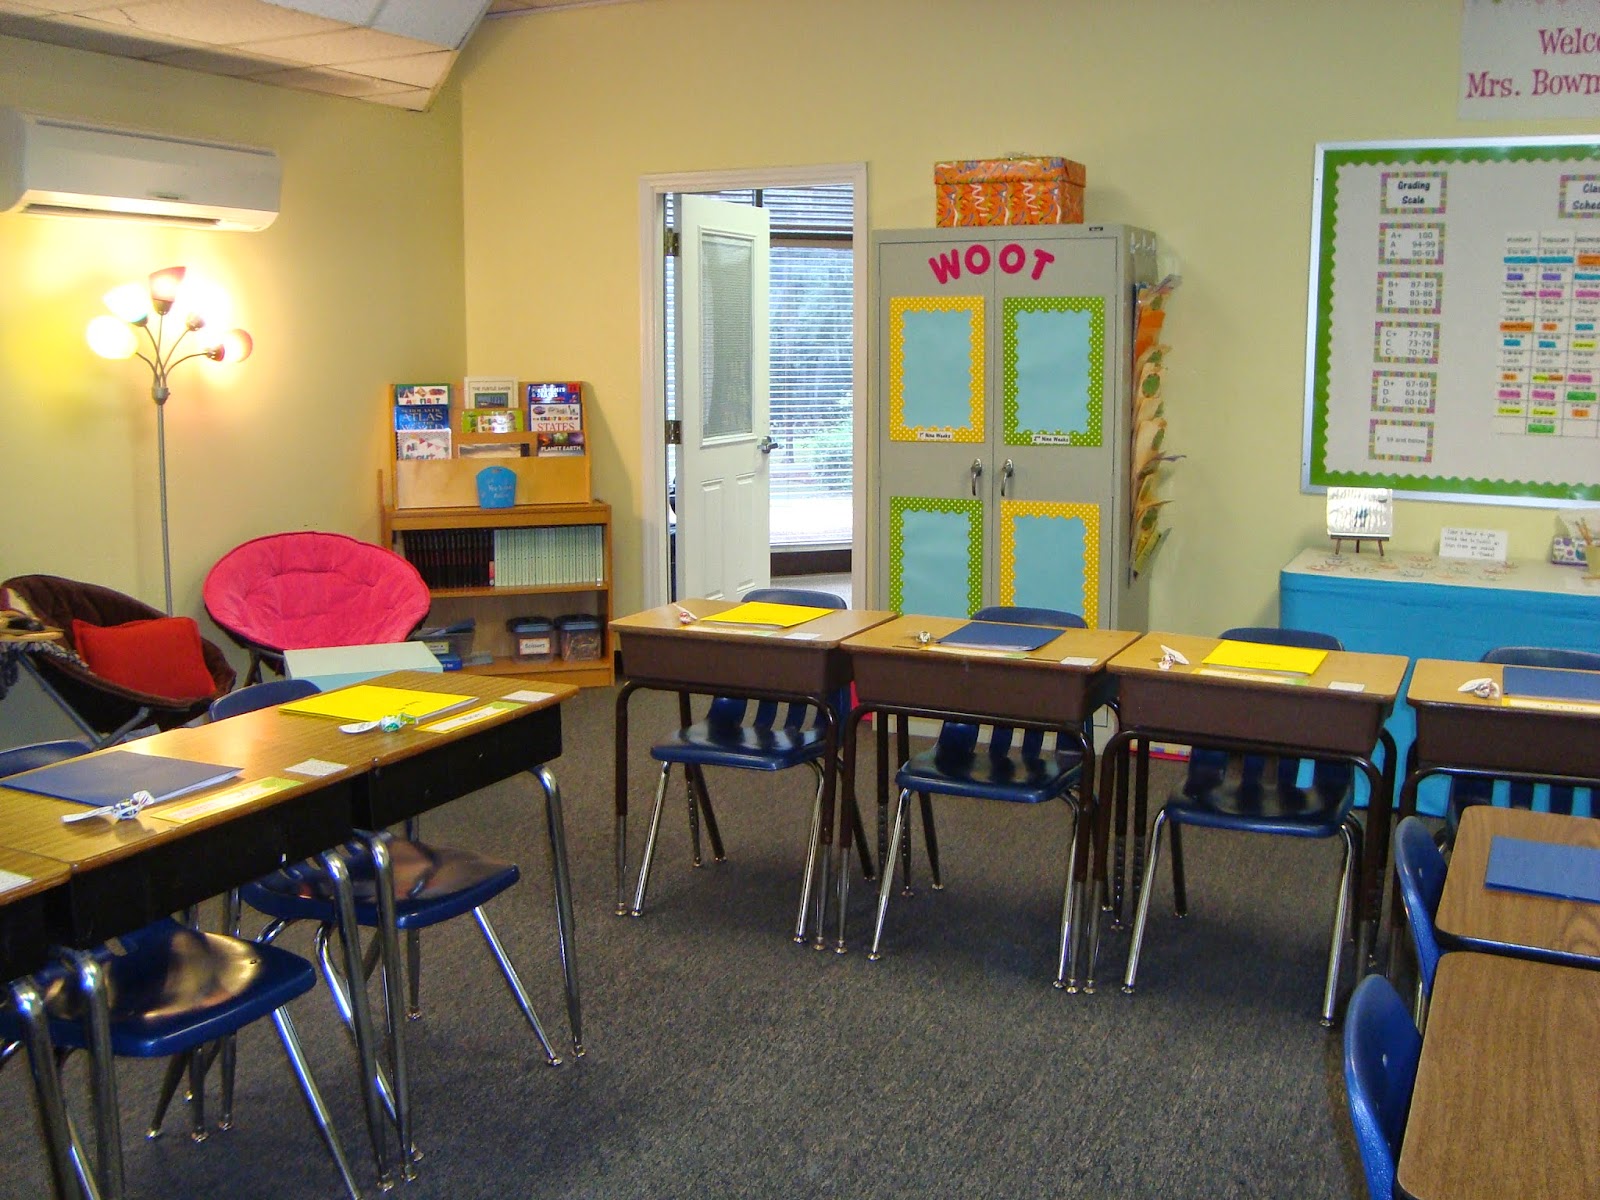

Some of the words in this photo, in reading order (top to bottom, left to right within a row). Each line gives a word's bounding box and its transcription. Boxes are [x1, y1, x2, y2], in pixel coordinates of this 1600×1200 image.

[1538, 27, 1600, 55] Welc
[1466, 71, 1521, 98] Mrs.
[1397, 181, 1431, 191] Grading
[1402, 195, 1425, 204] Scale
[1418, 231, 1433, 239] 100
[1412, 240, 1435, 248] 94-99
[928, 243, 1055, 284] WOOT
[1406, 380, 1429, 388] 67-69
[1405, 389, 1428, 397] 63-66
[1404, 398, 1427, 406] 60-62
[402, 412, 443, 422] ATLAS
[537, 422, 575, 432] STATES
